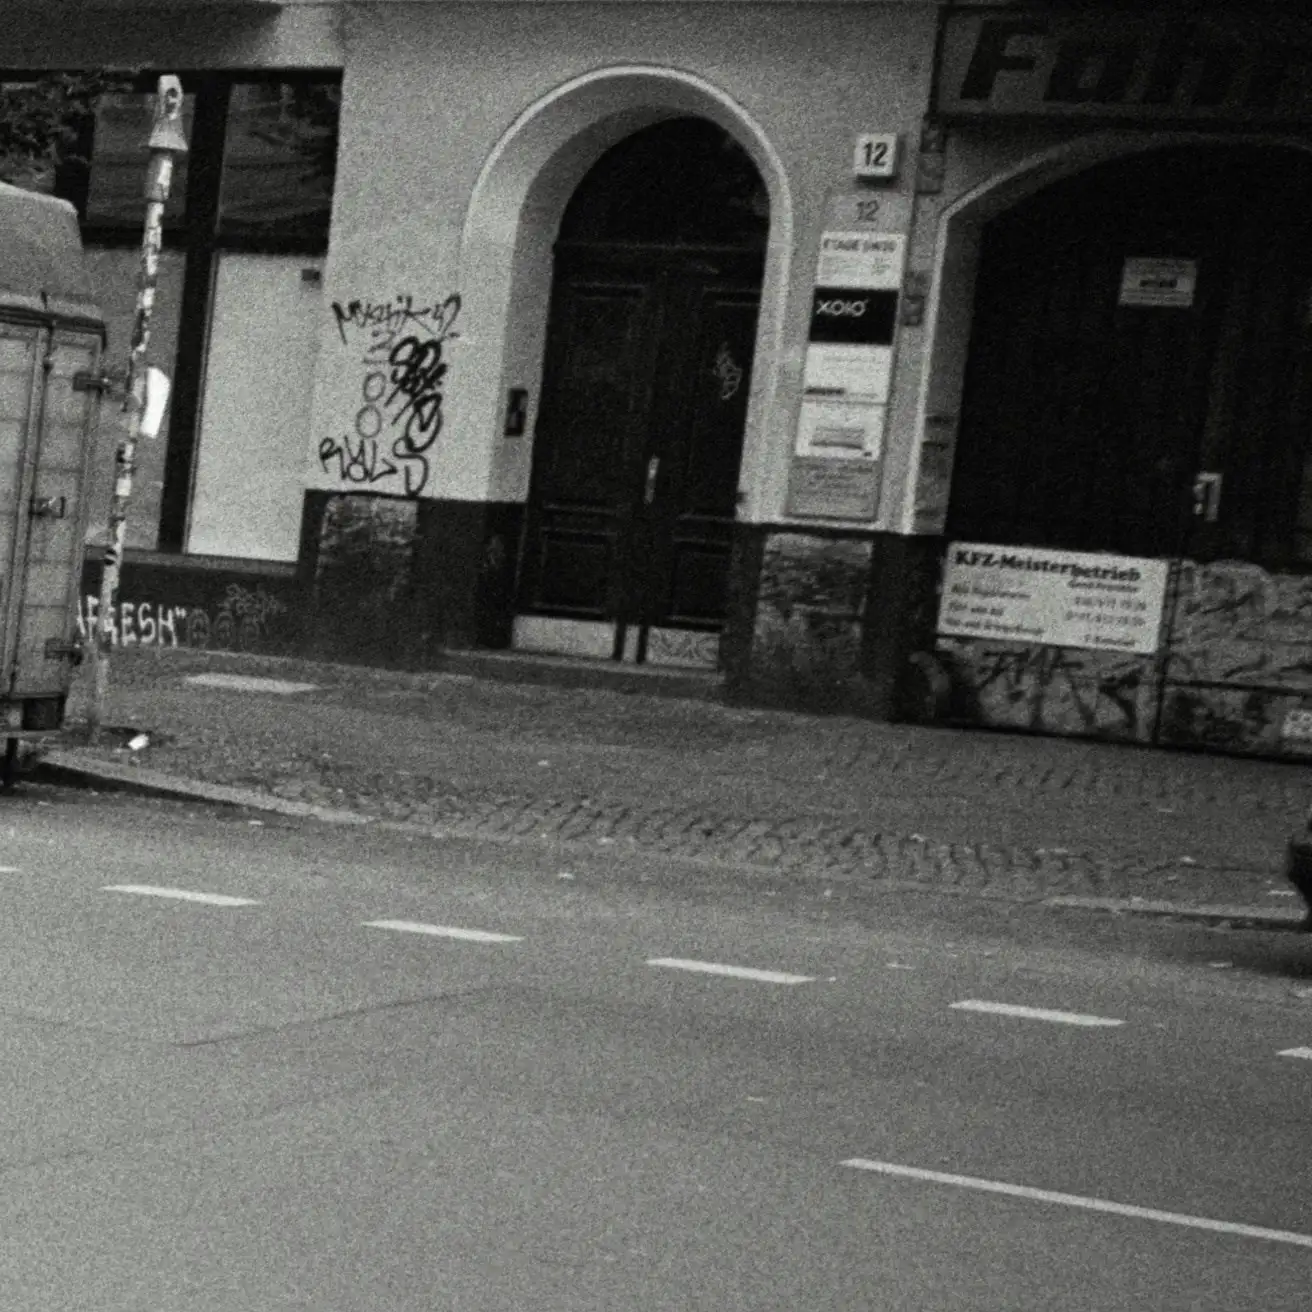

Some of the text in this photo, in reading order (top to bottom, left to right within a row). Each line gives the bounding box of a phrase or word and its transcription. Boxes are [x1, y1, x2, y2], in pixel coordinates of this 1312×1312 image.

[863, 141, 888, 168] 12
[855, 200, 879, 223] 12
[955, 550, 1141, 582] KFZ-Meisterbetrieb
